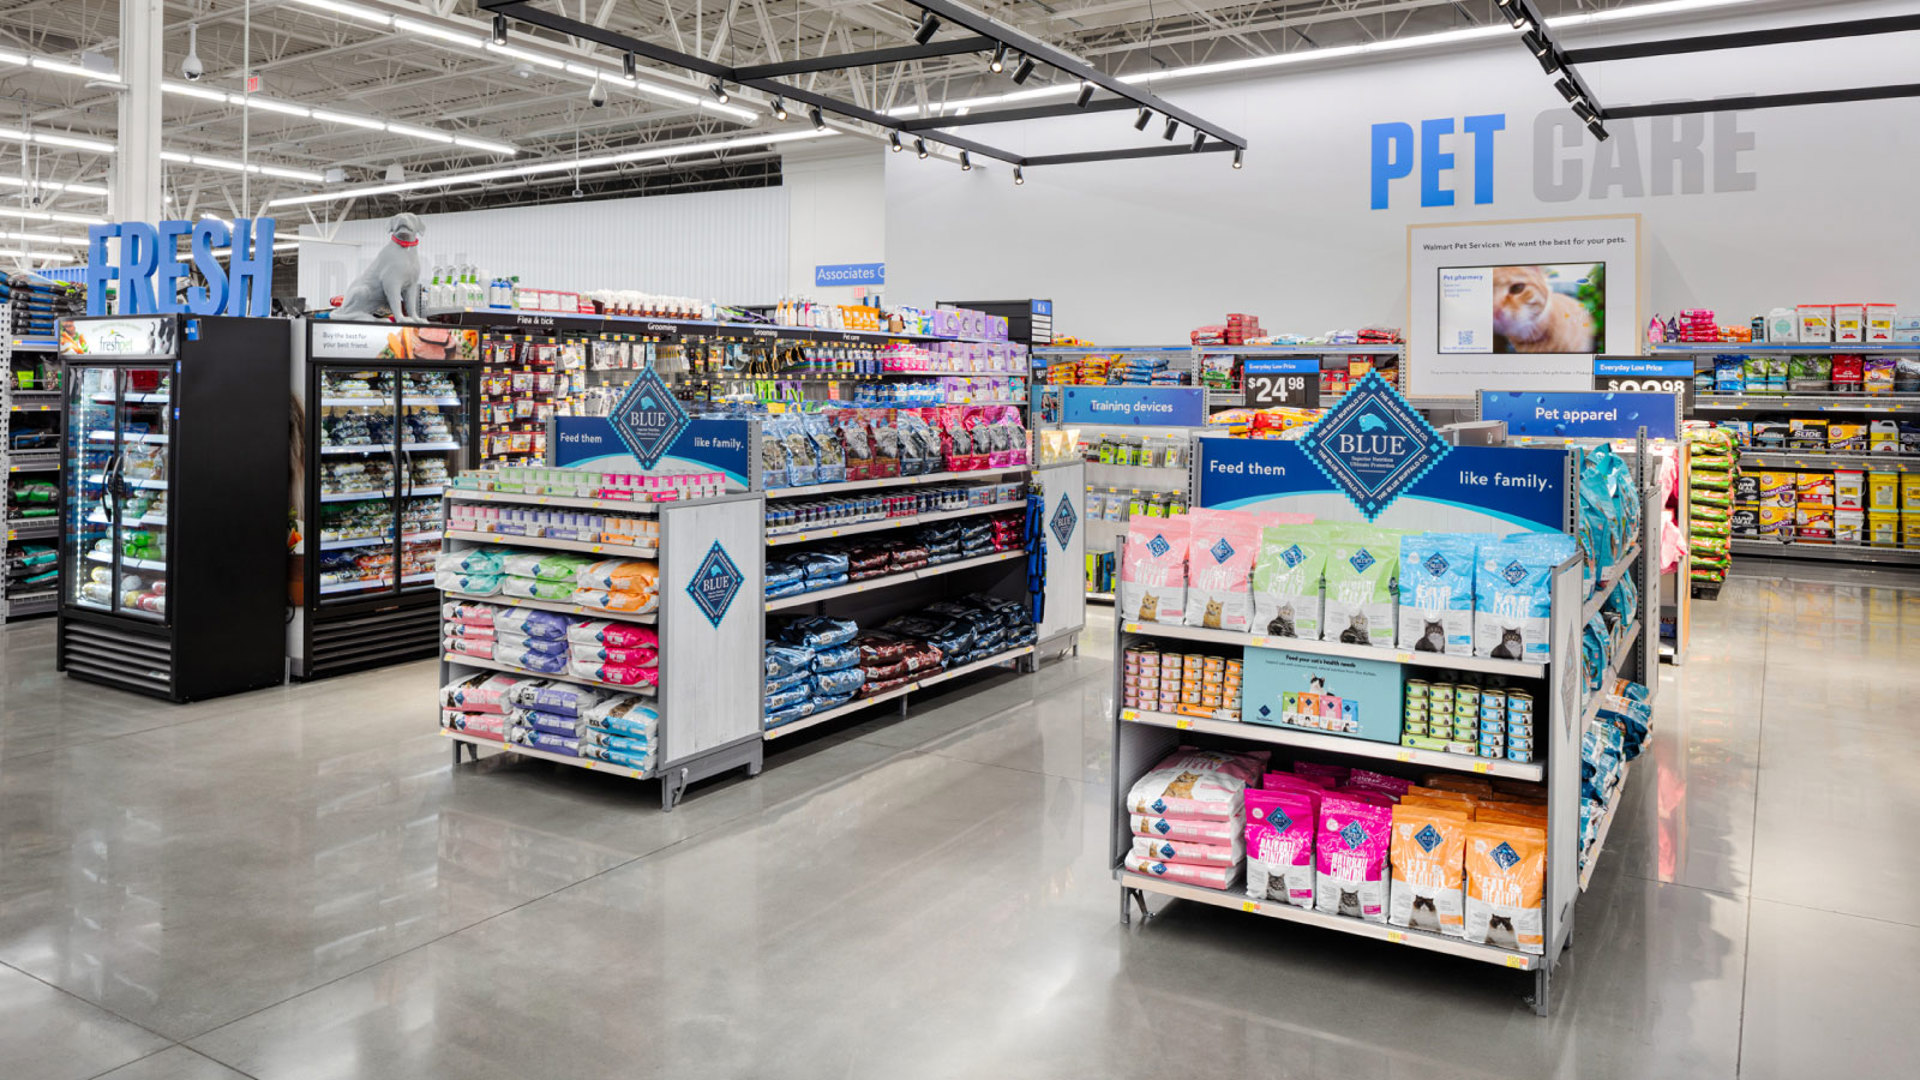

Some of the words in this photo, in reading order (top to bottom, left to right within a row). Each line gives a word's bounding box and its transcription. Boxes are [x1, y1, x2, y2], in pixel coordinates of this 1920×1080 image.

[1371, 113, 1505, 210] PET
[1533, 93, 1757, 203] CARE
[1423, 243, 1453, 251] Walmart
[1504, 240, 1516, 248] We
[1539, 239, 1552, 247] the
[1553, 238, 1571, 246] best
[1573, 237, 1585, 245] for
[1587, 238, 1605, 246] your
[1607, 236, 1626, 245] pets.
[86, 217, 276, 317] FRESH
[817, 266, 875, 281] Associates
[517, 315, 531, 325] Flea
[533, 317, 540, 325] &
[541, 317, 554, 325] tick
[648, 322, 677, 333] Grooming
[100, 336, 133, 354] freshpet
[1283, 362, 1296, 370] Price
[1600, 364, 1631, 372] Everyday
[1090, 400, 1132, 414] Training
[1133, 401, 1173, 414] devices
[1338, 399, 1359, 419] BUFFALO
[1535, 407, 1560, 420] Pet
[1563, 408, 1618, 423] apparel
[631, 411, 667, 427] BLUE
[1388, 400, 1401, 413] BLUE
[1399, 412, 1420, 434] BUFFALO
[560, 432, 580, 443] Feed
[581, 434, 602, 443] them
[1794, 430, 1822, 438] SLIDE
[694, 436, 710, 448] like
[712, 437, 744, 452] family.
[1339, 434, 1407, 456] BLUE
[1210, 460, 1244, 475] Feed
[1248, 462, 1286, 476] them
[1399, 461, 1421, 482] BUFFALO
[1337, 470, 1358, 492] BUFFALO
[1459, 470, 1488, 486] like
[1494, 471, 1553, 489] family.
[703, 575, 729, 592] BLUE
[1299, 656, 1311, 664] your
[1323, 658, 1339, 667] health
